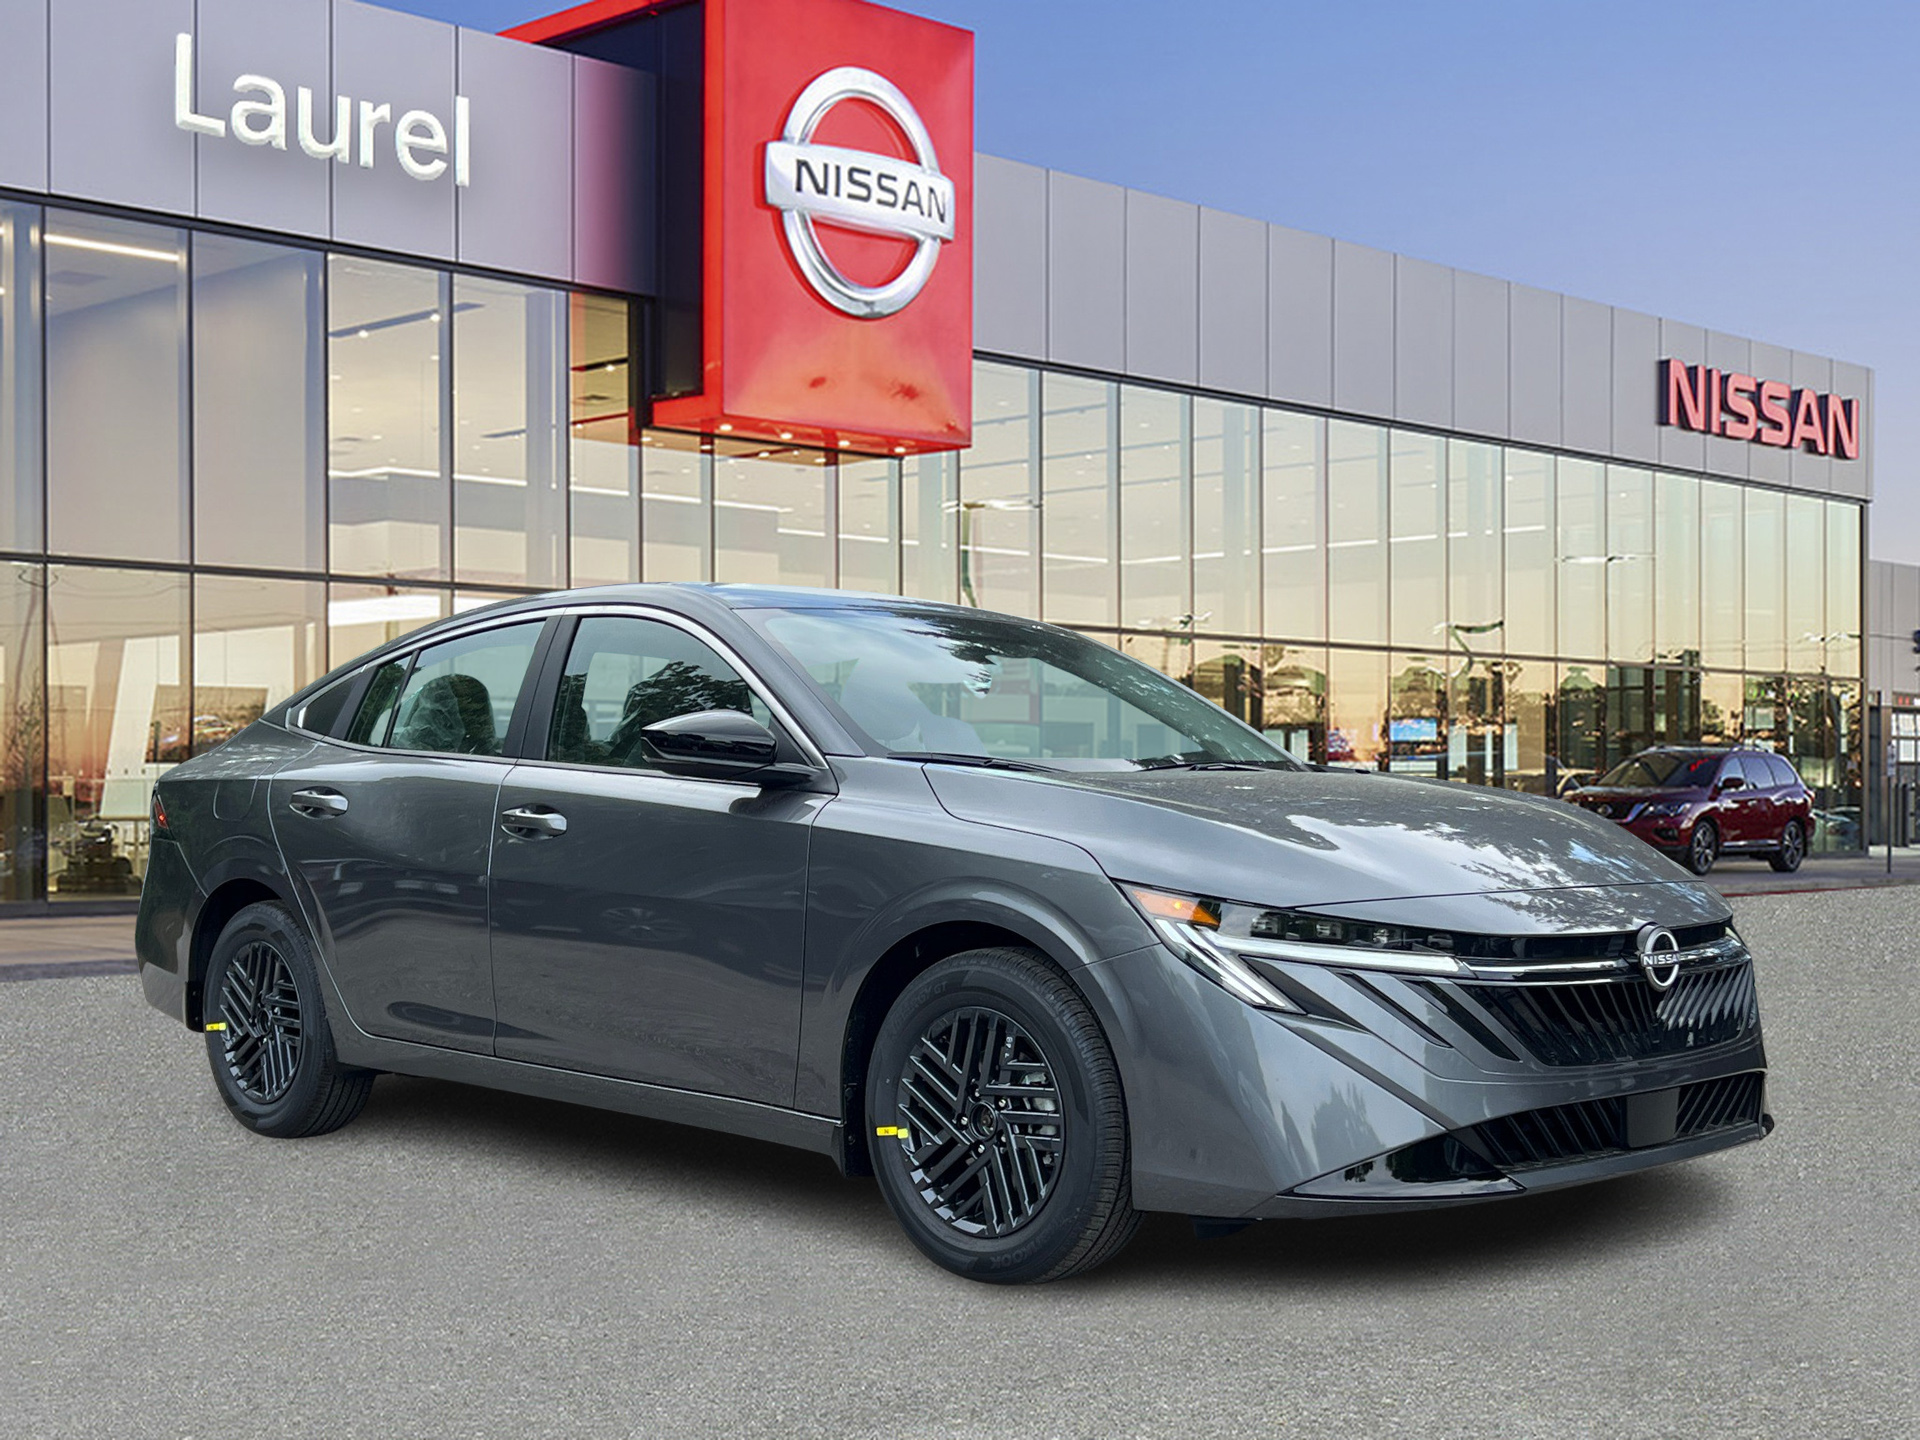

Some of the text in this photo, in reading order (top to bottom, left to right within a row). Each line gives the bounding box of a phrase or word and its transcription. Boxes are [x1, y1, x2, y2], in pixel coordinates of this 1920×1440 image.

[175, 32, 470, 188] Laurel
[794, 157, 947, 224] NISSAN
[1663, 358, 1860, 460] NISSAN
[1643, 953, 1679, 966] NISSA
